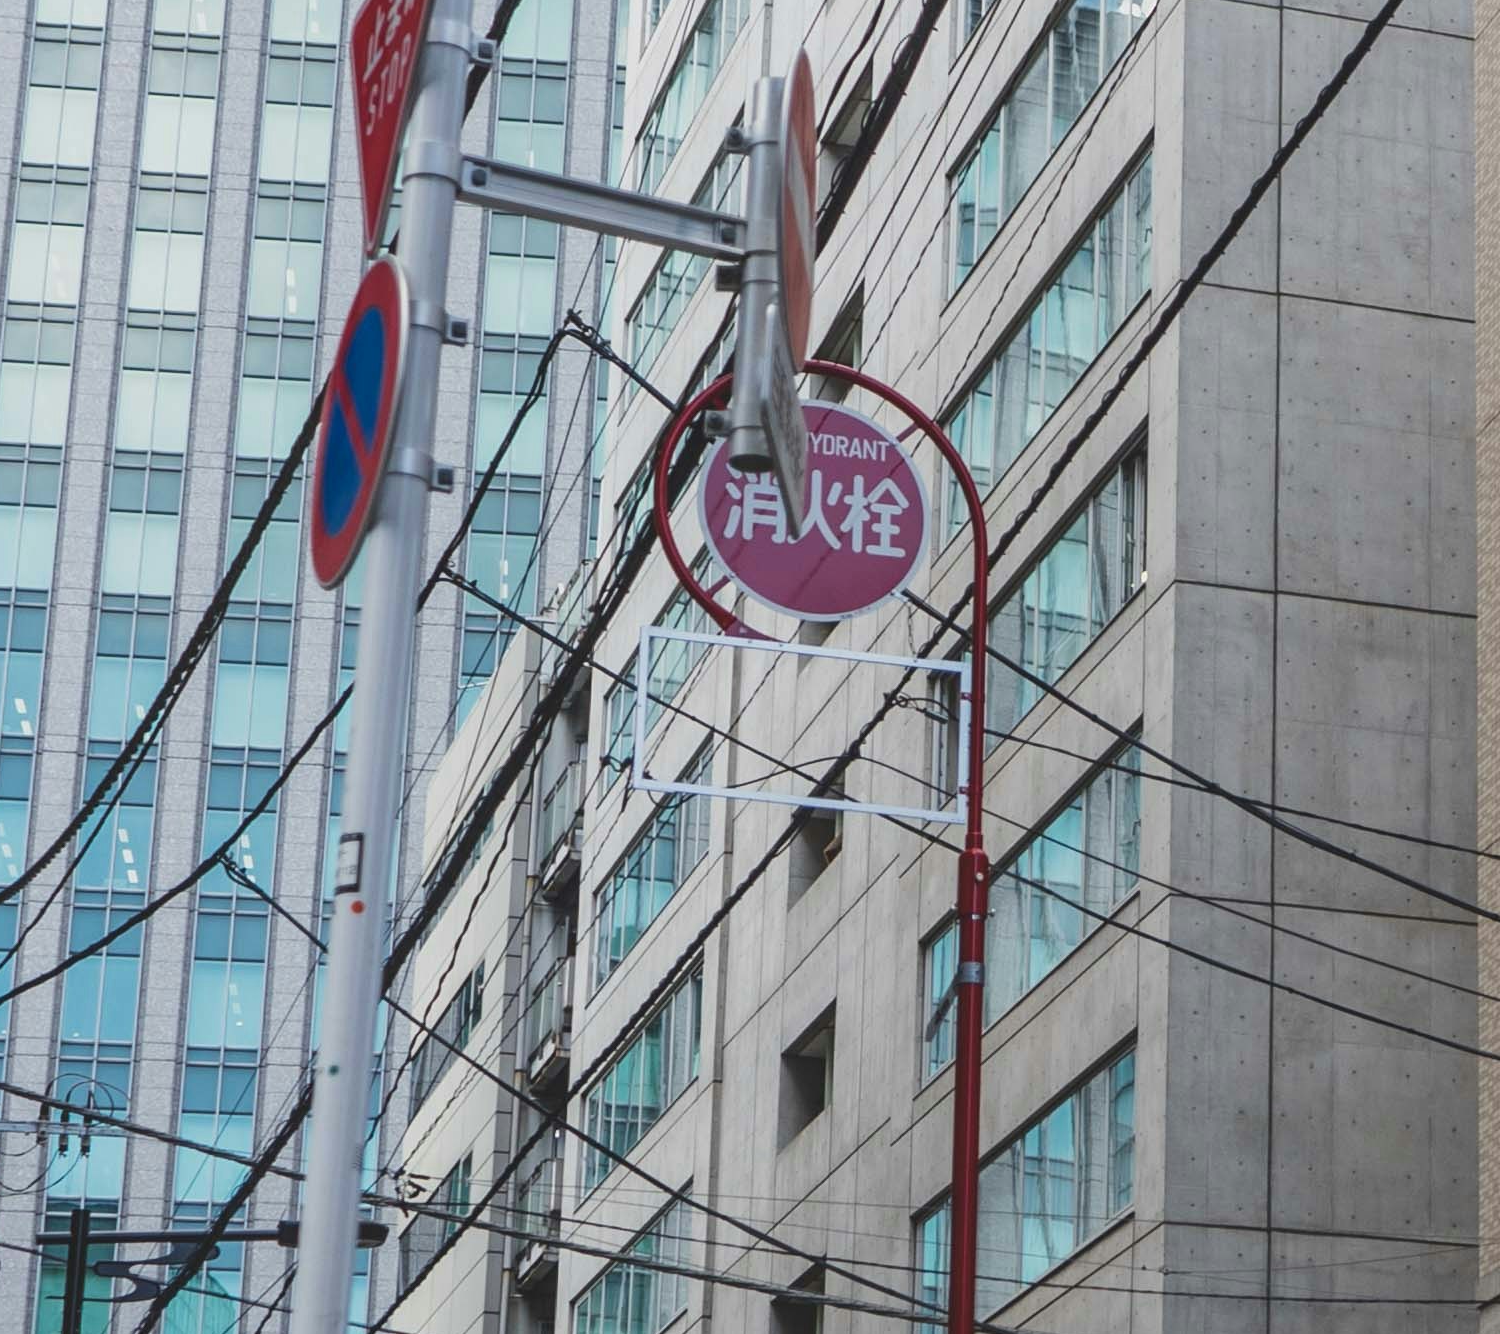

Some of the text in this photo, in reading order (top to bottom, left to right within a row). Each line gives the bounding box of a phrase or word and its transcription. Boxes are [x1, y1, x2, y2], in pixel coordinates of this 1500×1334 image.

[366, 32, 412, 136] STOP
[723, 463, 911, 558] 消火栓
